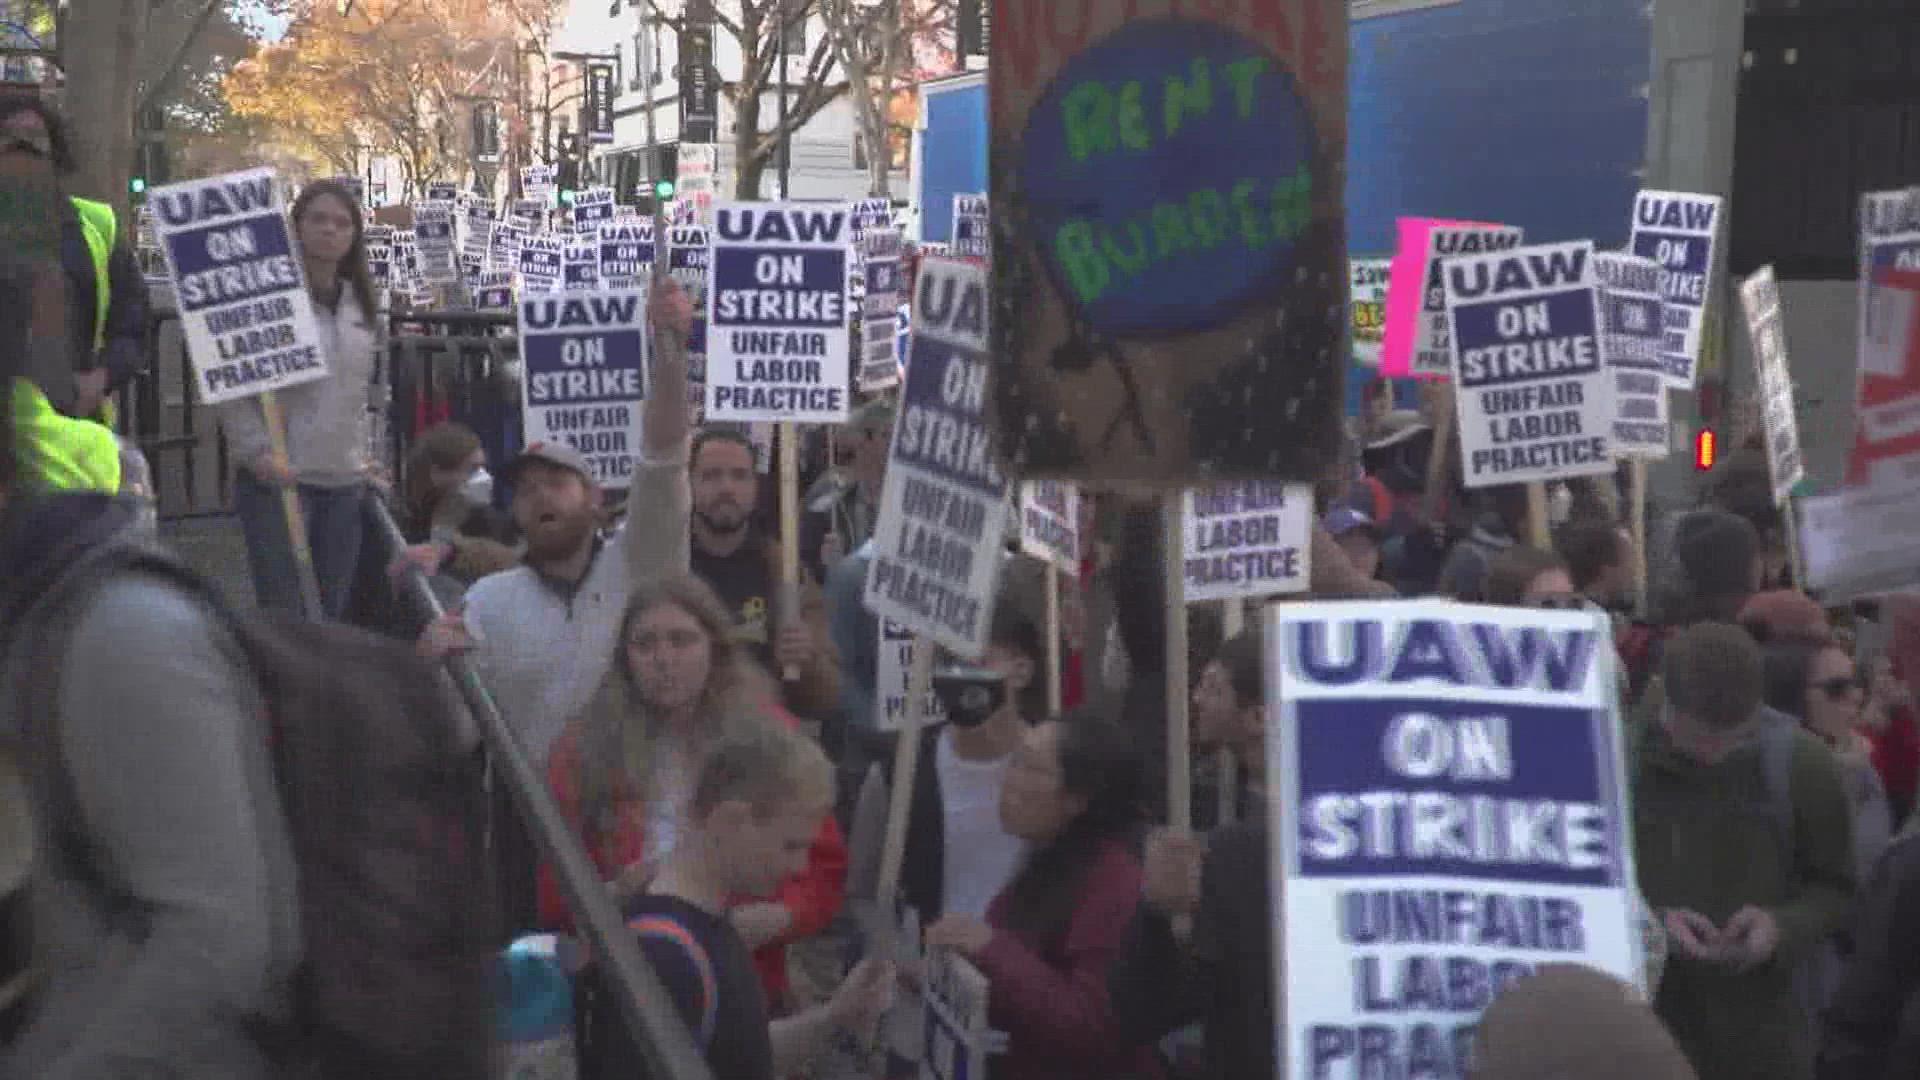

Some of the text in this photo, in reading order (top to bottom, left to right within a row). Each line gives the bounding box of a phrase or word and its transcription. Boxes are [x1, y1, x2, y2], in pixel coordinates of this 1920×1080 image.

[1059, 57, 1270, 161] RENT
[158, 177, 271, 226] UAW
[575, 190, 611, 204] UAW
[1638, 198, 1714, 231] UAW
[206, 226, 256, 261] ON
[601, 226, 654, 240] UAW
[672, 229, 709, 247] UA
[716, 209, 846, 243] UAW
[1433, 231, 1517, 253] UAW
[521, 239, 561, 250] UAW
[565, 249, 598, 261] UA
[1656, 239, 1689, 268] ON
[184, 254, 298, 304] STRIKE
[756, 255, 804, 284] ON
[1451, 249, 1589, 298] UAW
[1657, 271, 1705, 301] RIKE
[205, 297, 293, 336] UNFAIR
[524, 296, 639, 329] UAW
[718, 289, 841, 322] STRIKE
[920, 272, 983, 334] UA
[1498, 302, 1549, 337] ON
[216, 324, 295, 360] LABOR
[560, 337, 606, 367] ON
[731, 332, 827, 357] UNFAIR
[1462, 336, 1594, 380] STRIKE
[204, 345, 322, 393] PRACTICE
[531, 368, 640, 400] STRIKE
[735, 359, 822, 385] LABOR
[943, 355, 989, 414] ON
[713, 386, 843, 413] PRACTICE
[1480, 381, 1585, 415] UNFAIR
[546, 405, 630, 431] UNFAIR
[1489, 411, 1583, 443] LABOR
[1473, 437, 1608, 475] PRACTICE
[903, 475, 986, 543] UNFAIR
[1199, 515, 1280, 550] LABOR
[898, 519, 974, 585] LABOR
[1185, 547, 1298, 584] PRACTICE
[872, 557, 981, 642] PRACTICE
[1290, 617, 1599, 695] UAW
[1380, 711, 1513, 782] ON
[1303, 789, 1612, 870] STRIKE
[1337, 887, 1588, 953] UNFAIR
